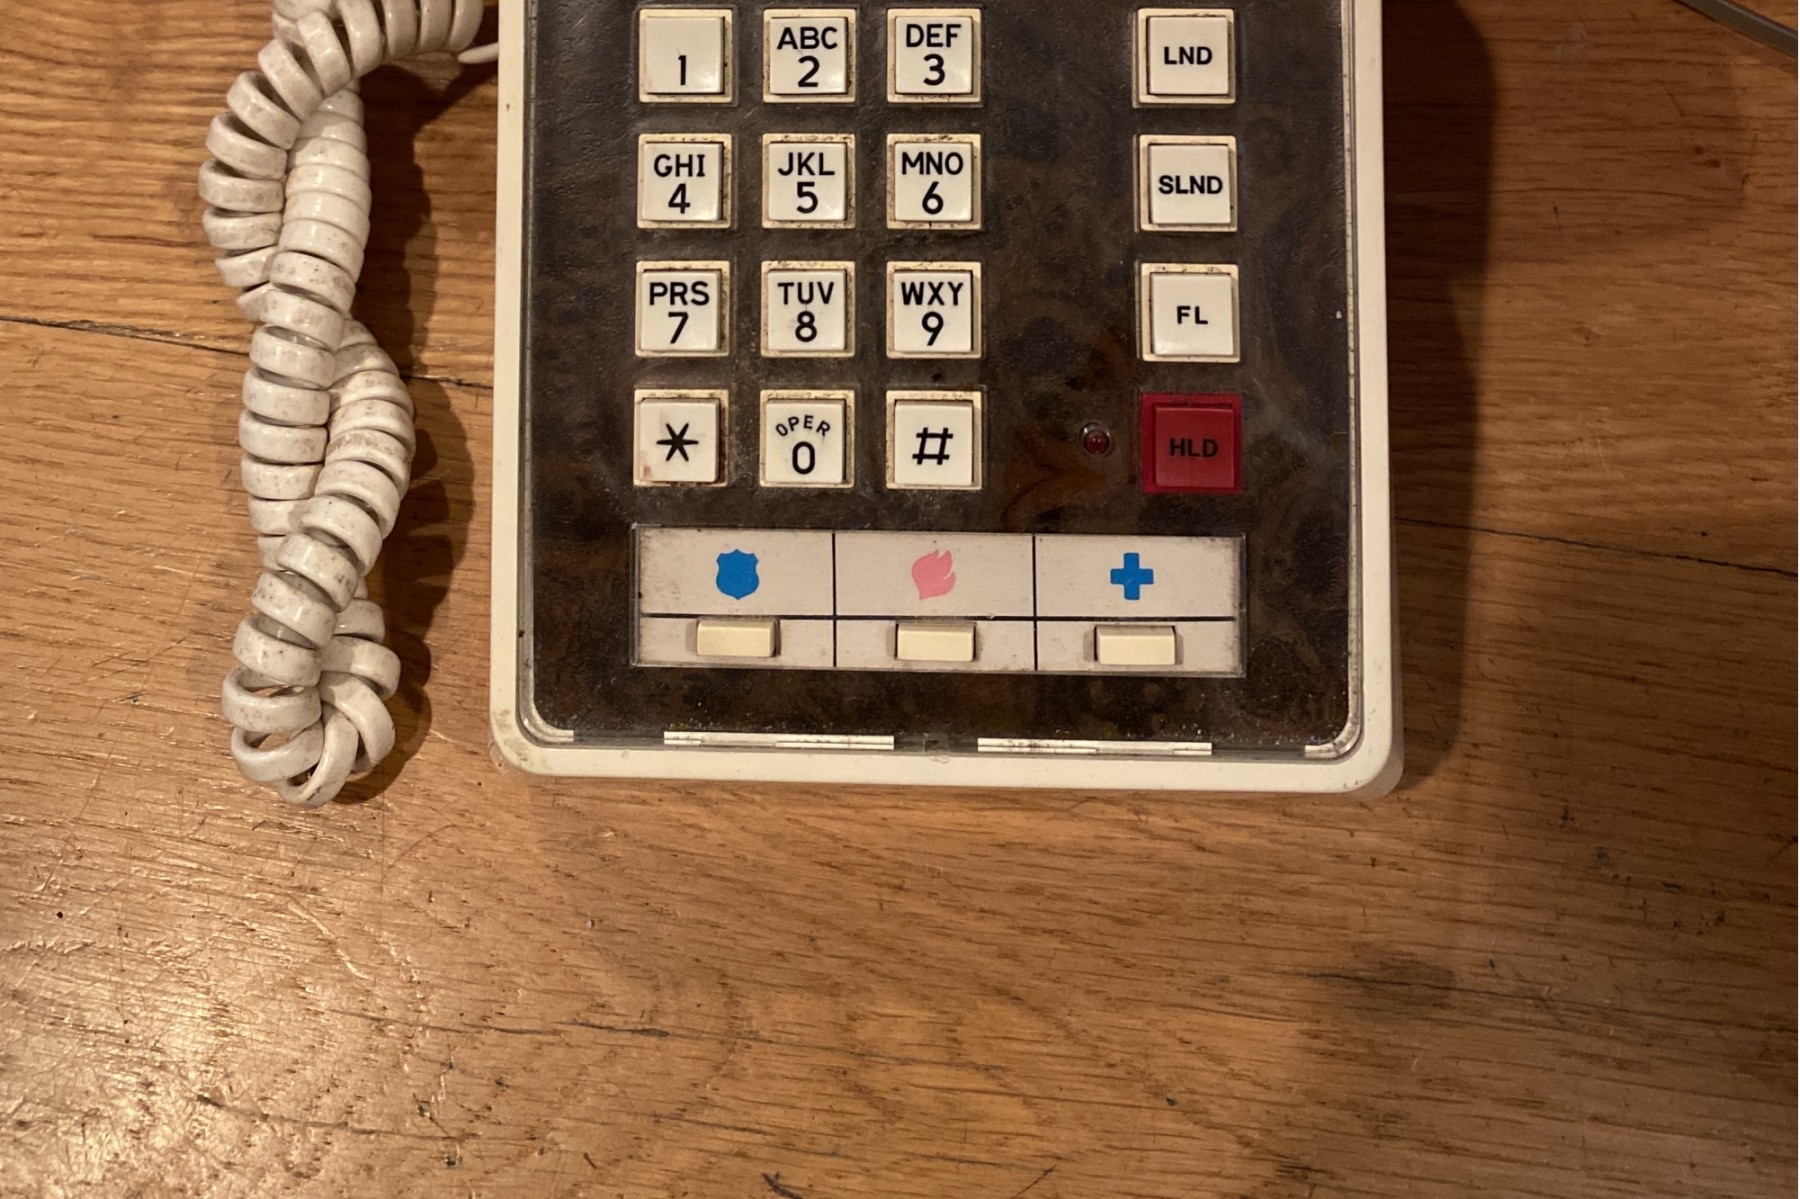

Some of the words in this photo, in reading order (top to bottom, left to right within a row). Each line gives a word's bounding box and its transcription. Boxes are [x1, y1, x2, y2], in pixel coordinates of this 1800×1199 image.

[777, 26, 839, 50] ABC
[905, 23, 962, 48] DEF
[1163, 46, 1213, 66] LND
[677, 54, 687, 86] 1
[797, 55, 821, 88] 2
[922, 53, 946, 86] 3
[653, 153, 706, 178] GHI
[777, 151, 836, 177] JKL
[901, 151, 964, 176] MNO
[796, 181, 819, 214] 5
[921, 181, 944, 215] 6
[1158, 174, 1224, 196] SLND
[667, 183, 691, 214] 4
[649, 280, 710, 306] PRS
[777, 280, 835, 306] TUV
[900, 280, 964, 306] WXY
[667, 311, 690, 344] 7
[794, 310, 818, 343] 8
[921, 311, 944, 346] 9
[1176, 305, 1209, 326] FL
[775, 414, 832, 438] OPER
[791, 441, 816, 475] 0
[912, 427, 954, 465] #
[1169, 437, 1219, 458] HLD
